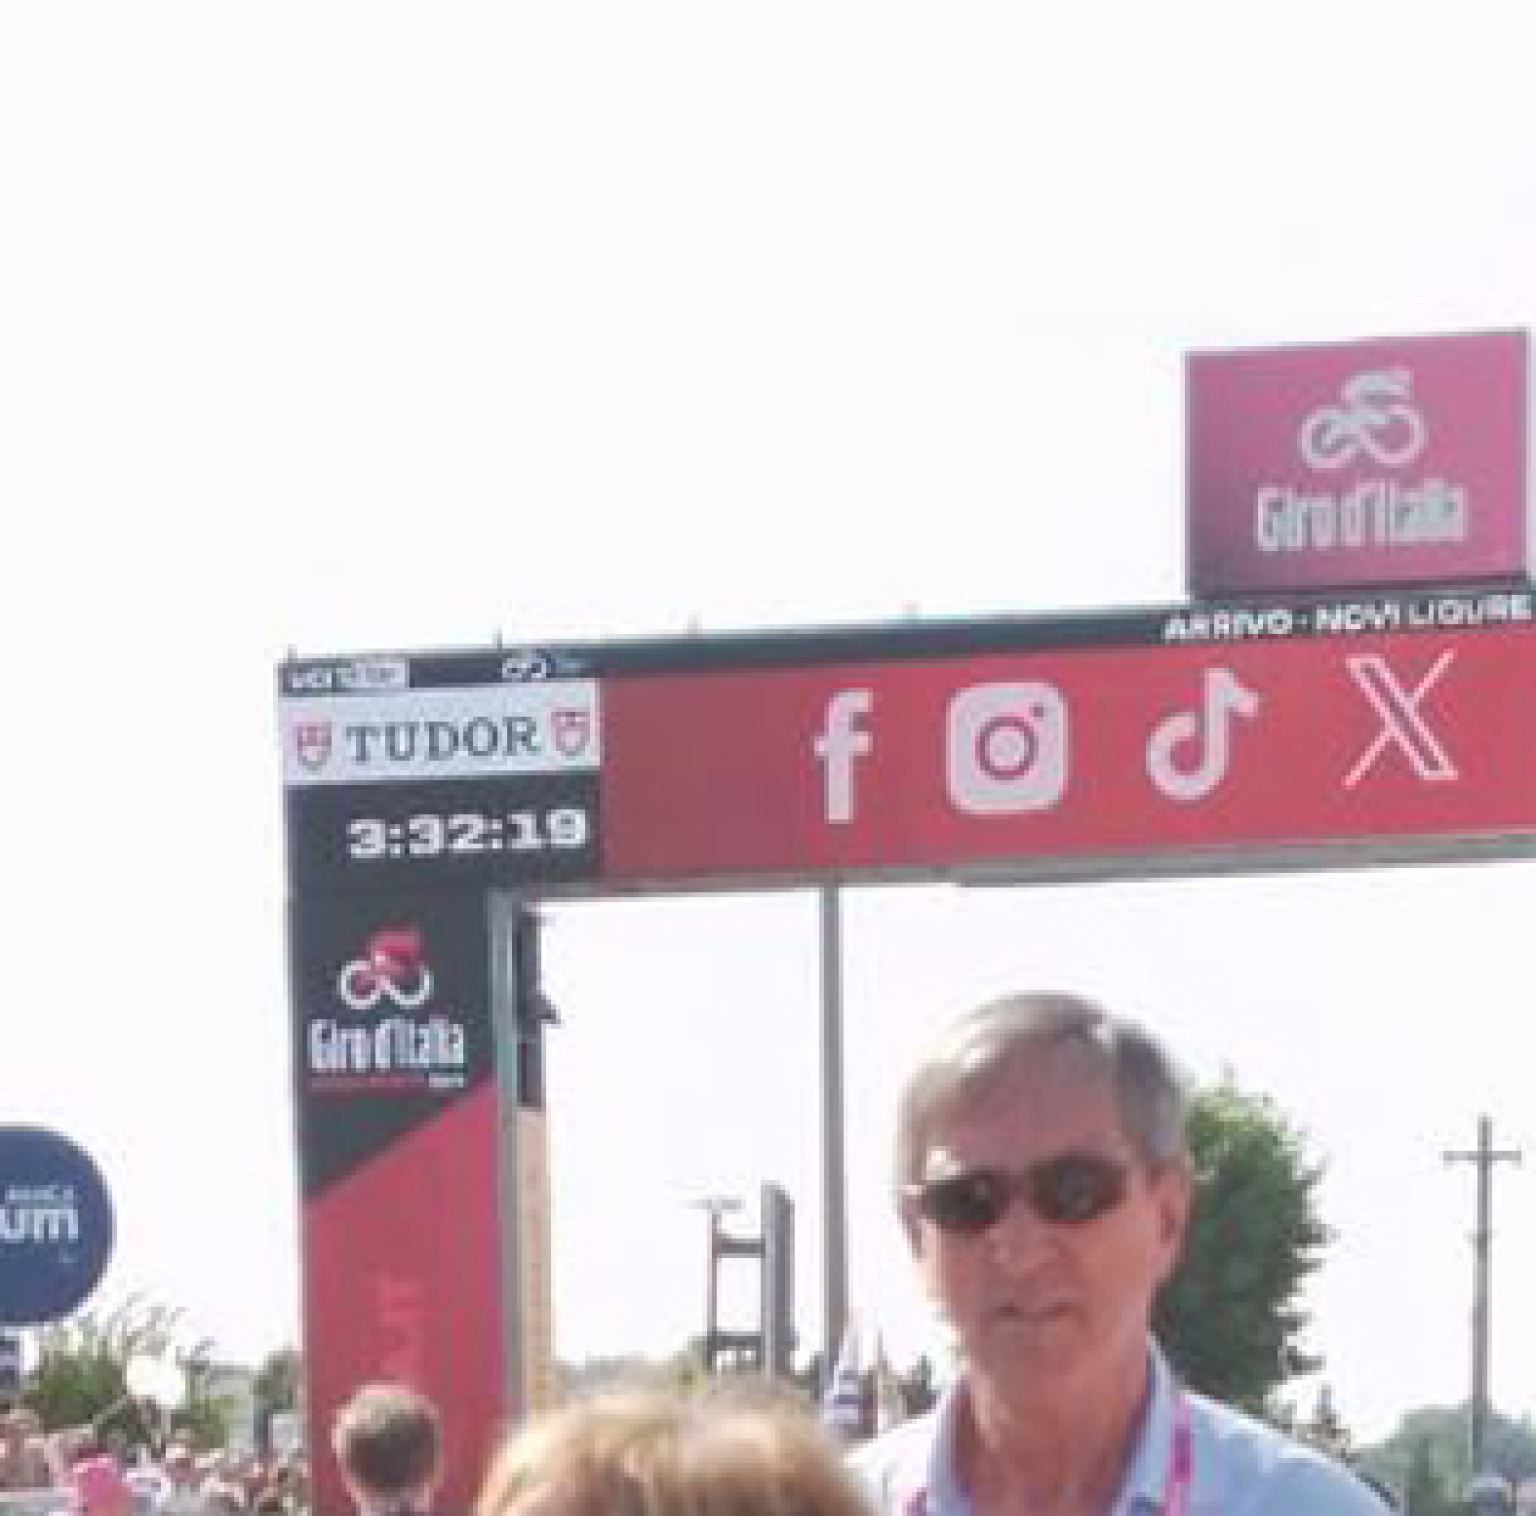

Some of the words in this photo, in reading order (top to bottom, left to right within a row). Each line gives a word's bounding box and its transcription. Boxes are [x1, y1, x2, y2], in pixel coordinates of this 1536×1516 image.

[1164, 611, 1293, 642] ARRIVO
[1315, 602, 1400, 632] NOVI
[346, 716, 541, 763] TUDOR
[347, 808, 588, 859] 3:32:19
